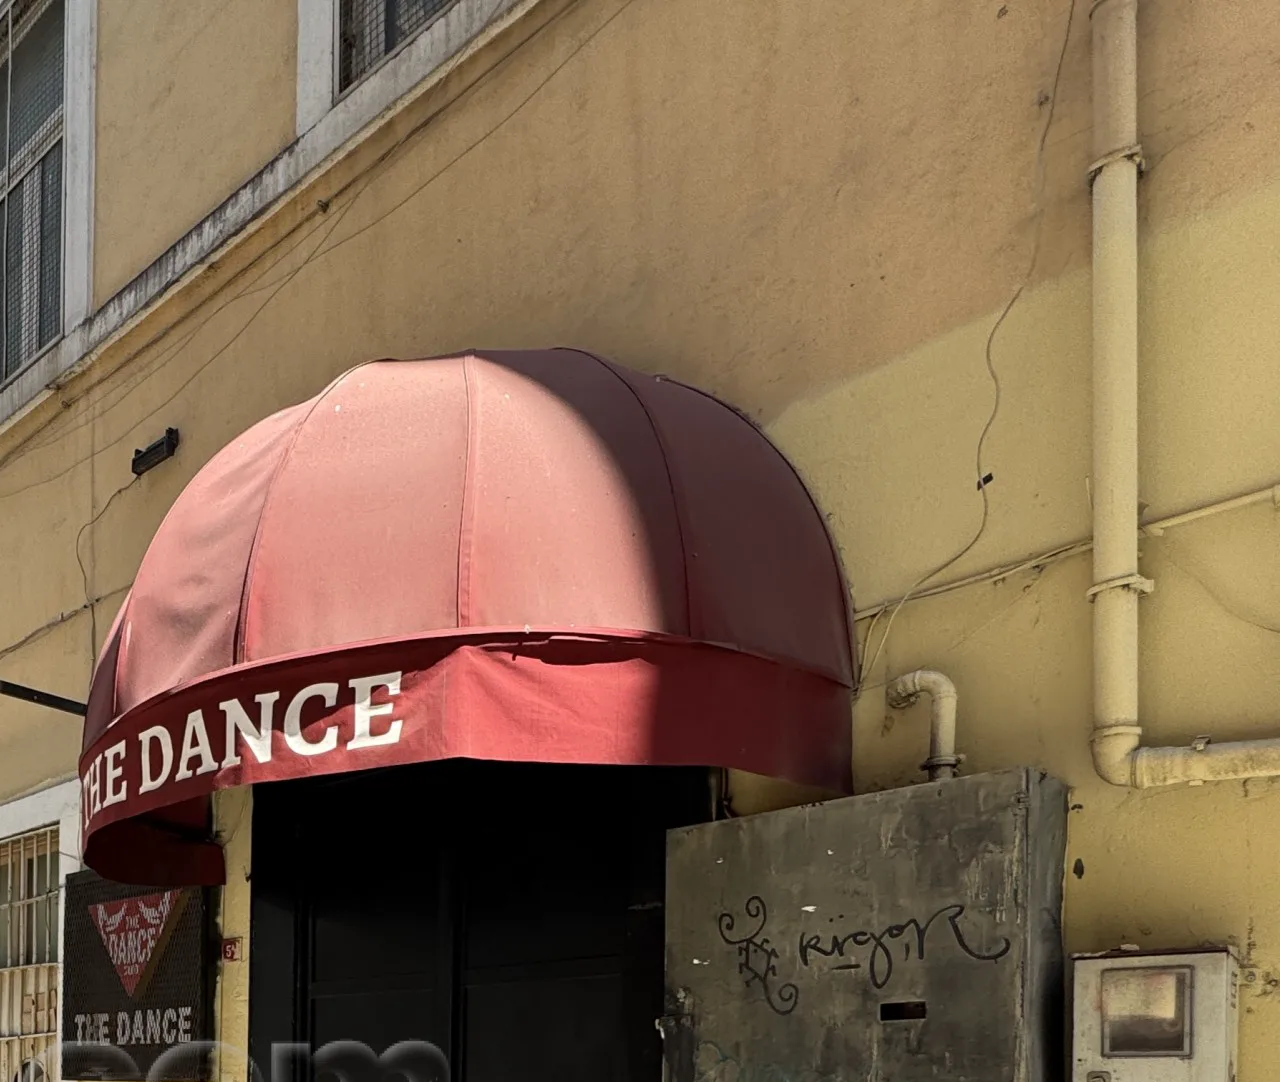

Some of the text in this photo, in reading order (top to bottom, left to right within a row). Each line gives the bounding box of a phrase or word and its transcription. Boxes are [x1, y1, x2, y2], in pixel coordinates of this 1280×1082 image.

[82, 670, 403, 830] THE DANCE
[74, 1006, 192, 1046] THE DANCE
